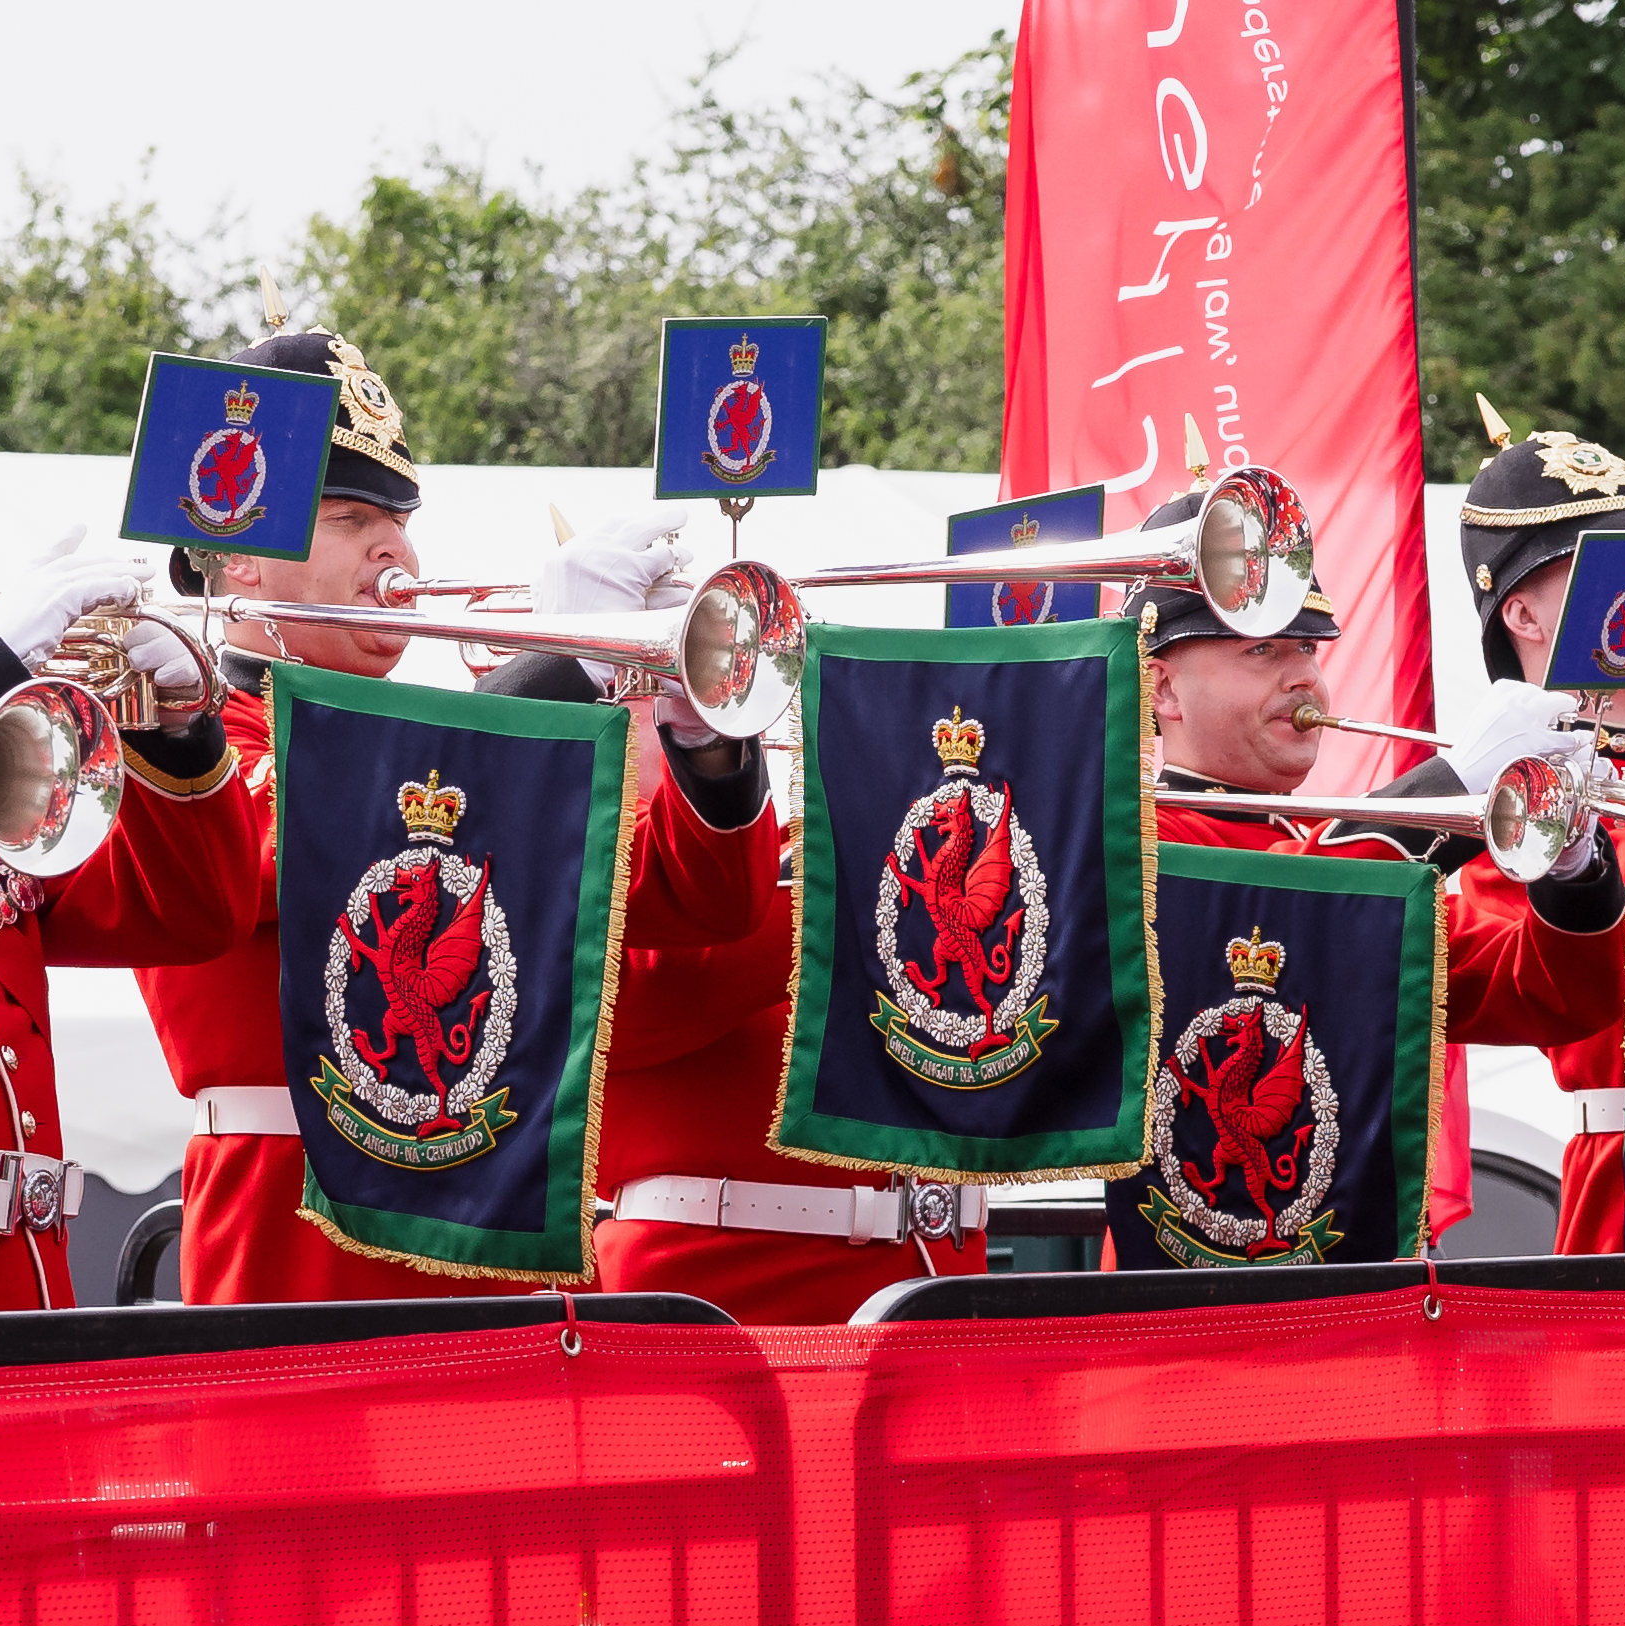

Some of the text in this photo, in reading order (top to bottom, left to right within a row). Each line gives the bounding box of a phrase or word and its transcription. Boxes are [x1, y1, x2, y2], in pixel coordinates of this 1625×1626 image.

[889, 1035, 917, 1066] GWELL
[921, 1058, 954, 1081] ANGAU
[959, 1067, 975, 1083] NA
[330, 1104, 359, 1139] GWELL
[362, 1132, 400, 1160] ANGAU
[404, 1147, 420, 1163] NA
[1160, 1228, 1188, 1261] GWELL
